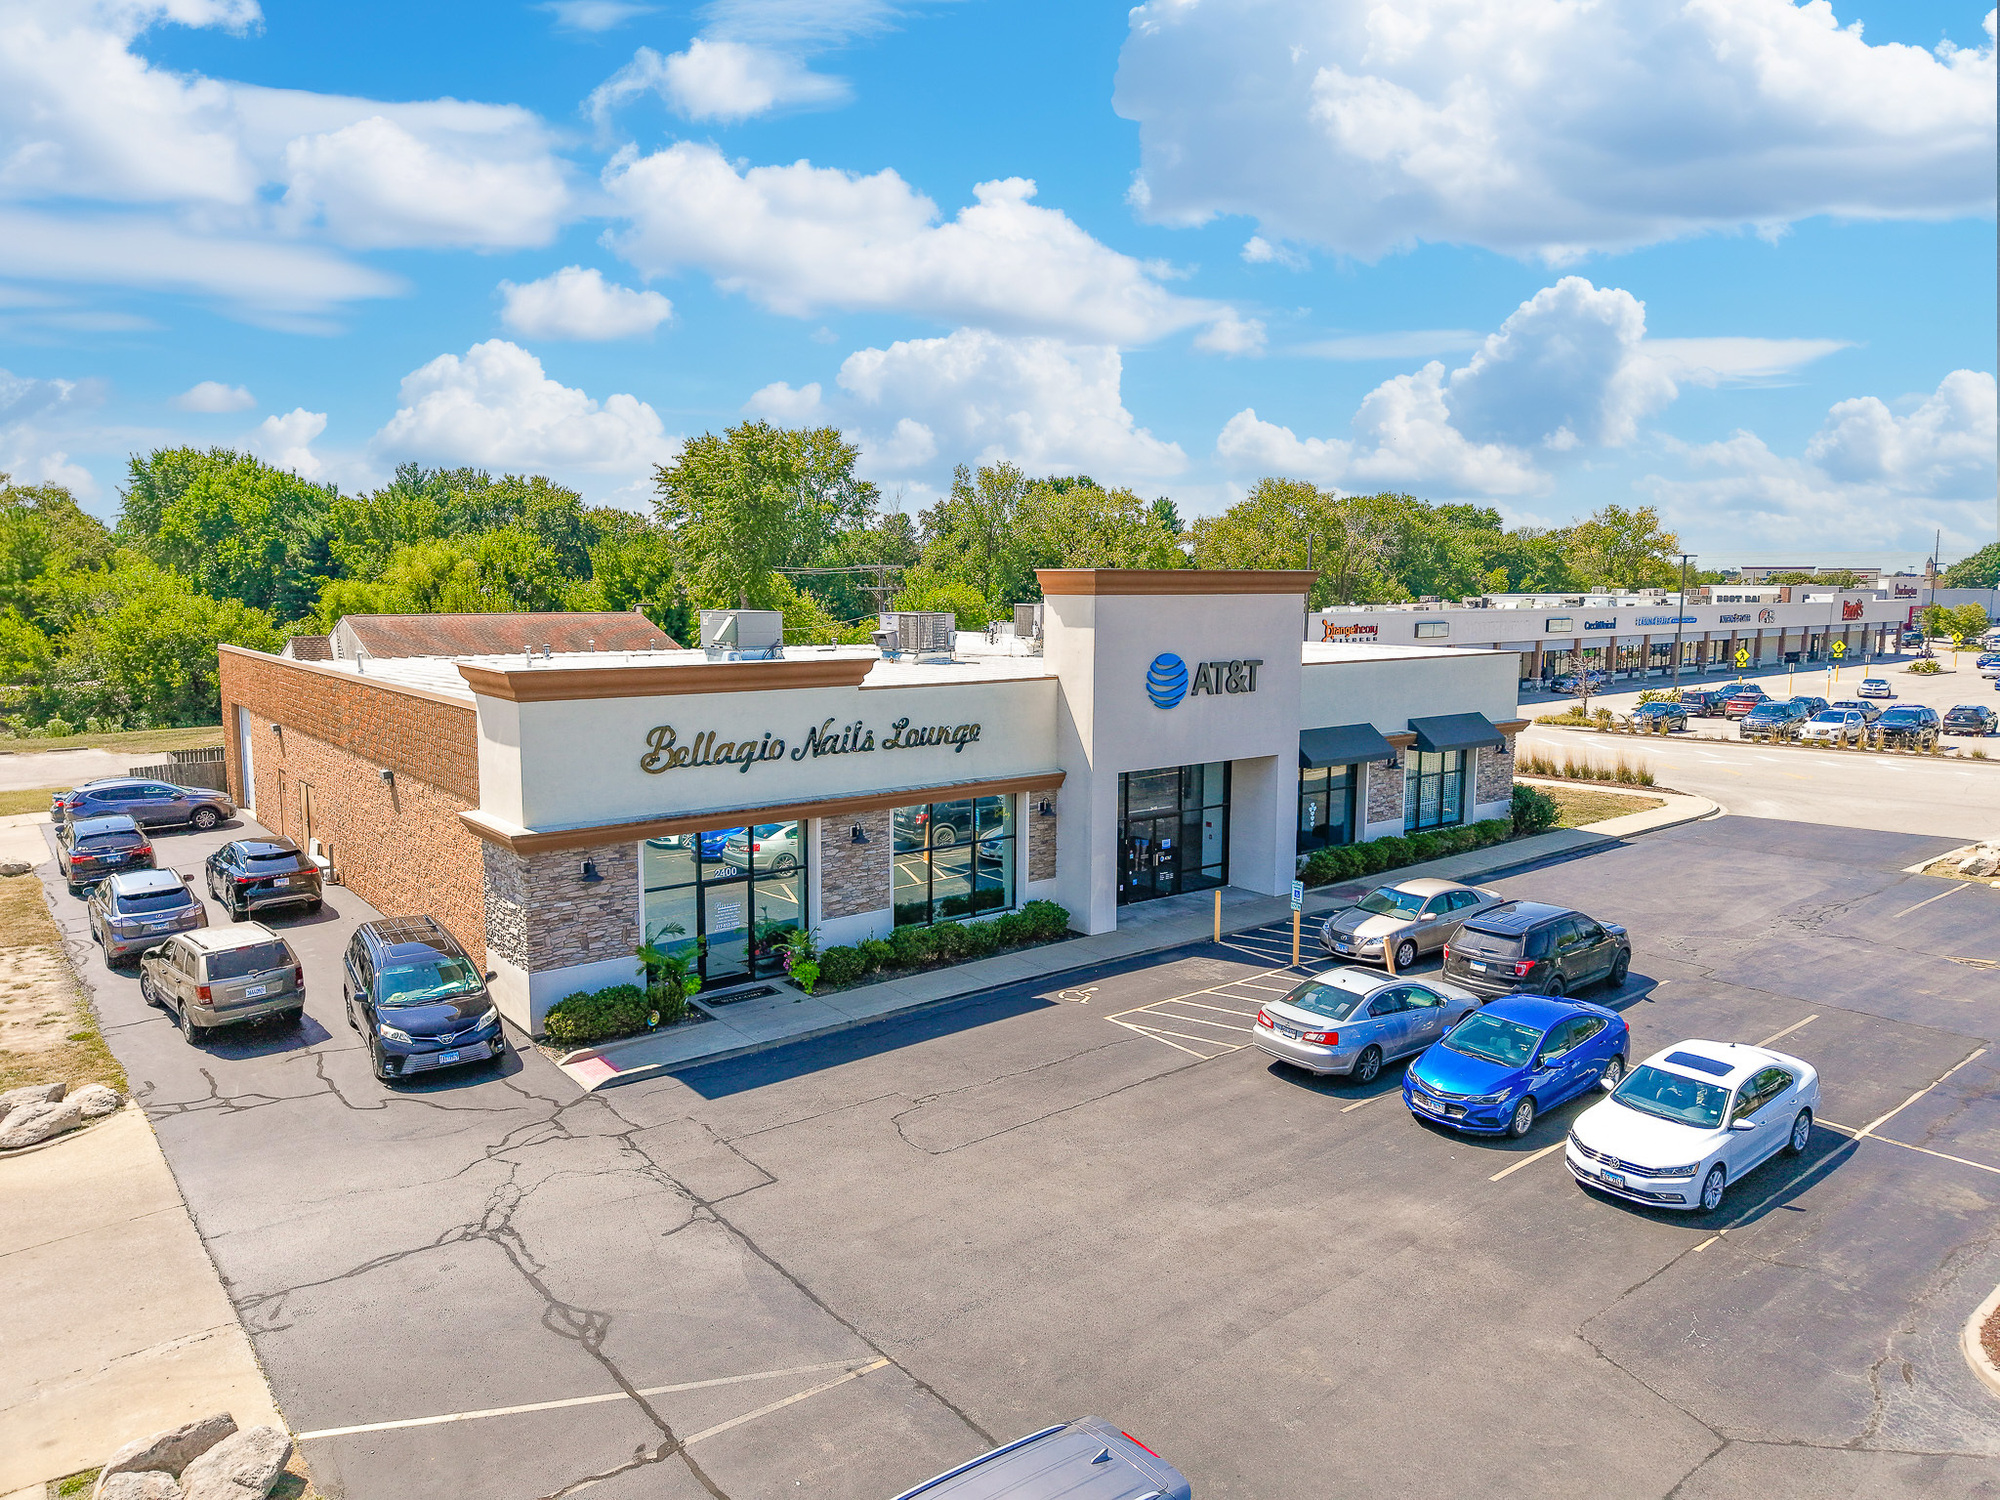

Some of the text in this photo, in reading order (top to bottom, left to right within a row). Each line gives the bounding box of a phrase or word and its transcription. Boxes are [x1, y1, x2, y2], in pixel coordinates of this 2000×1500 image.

[1716, 594, 1742, 603] BOOT
[1190, 659, 1264, 697] AT&T
[640, 716, 982, 774] Bellagio Nails Lounge
[713, 866, 738, 879] 2400
